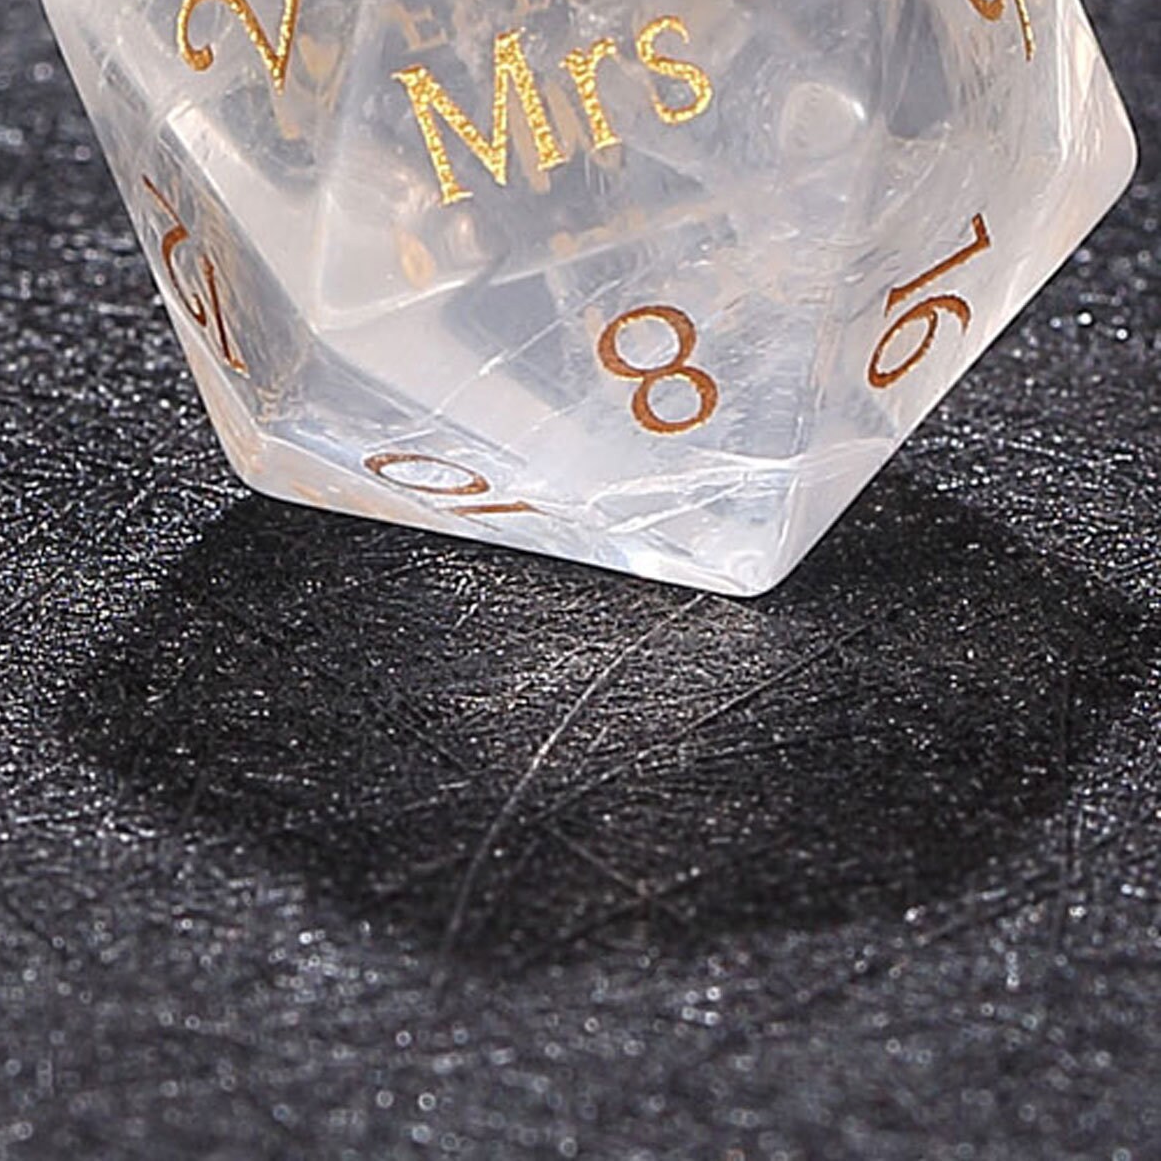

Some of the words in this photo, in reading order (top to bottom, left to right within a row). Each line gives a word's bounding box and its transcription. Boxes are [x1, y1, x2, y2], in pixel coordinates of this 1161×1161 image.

[391, 15, 713, 205] Mrs
[596, 304, 719, 435] 8
[867, 212, 991, 390] 16
